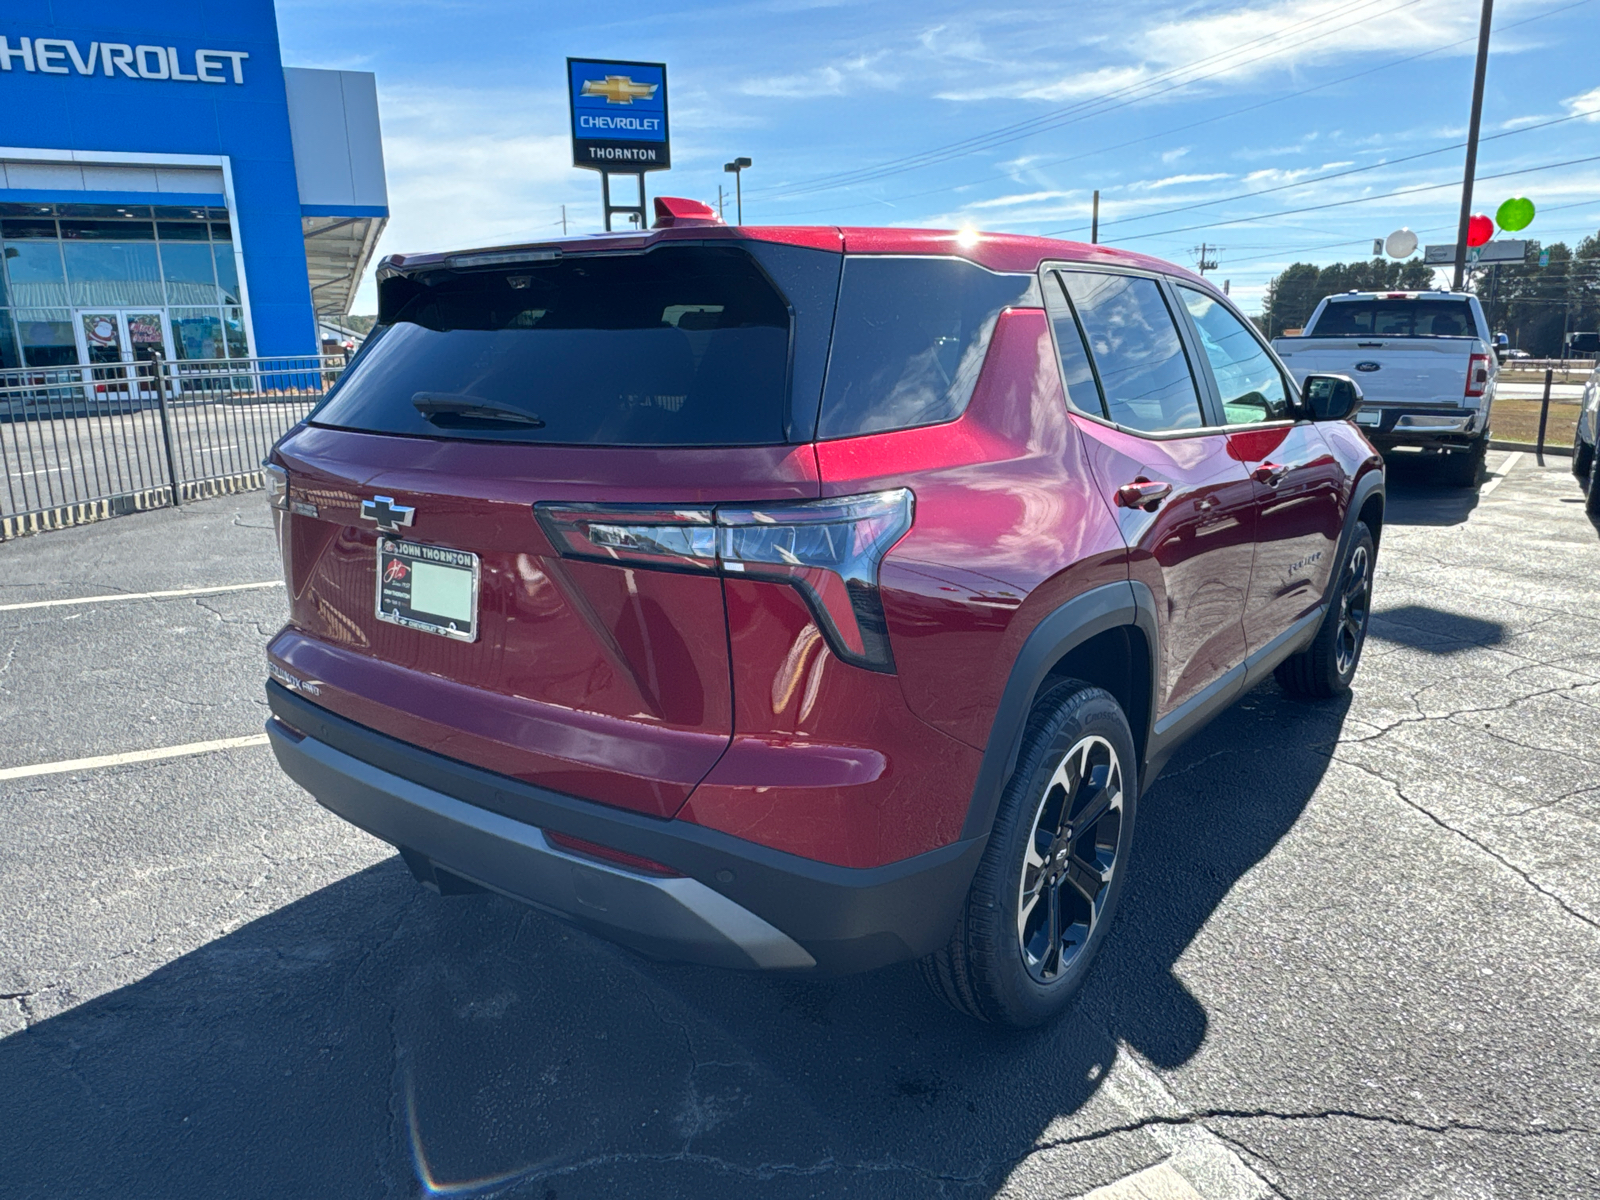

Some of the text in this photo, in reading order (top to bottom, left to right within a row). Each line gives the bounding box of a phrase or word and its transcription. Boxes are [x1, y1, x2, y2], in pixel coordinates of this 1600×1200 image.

[580, 115, 660, 130] CHEVROLET
[588, 147, 656, 160] THORNTON
[398, 543, 421, 556] JOHN
[422, 547, 471, 566] THORNTON
[302, 681, 320, 696] AWD
